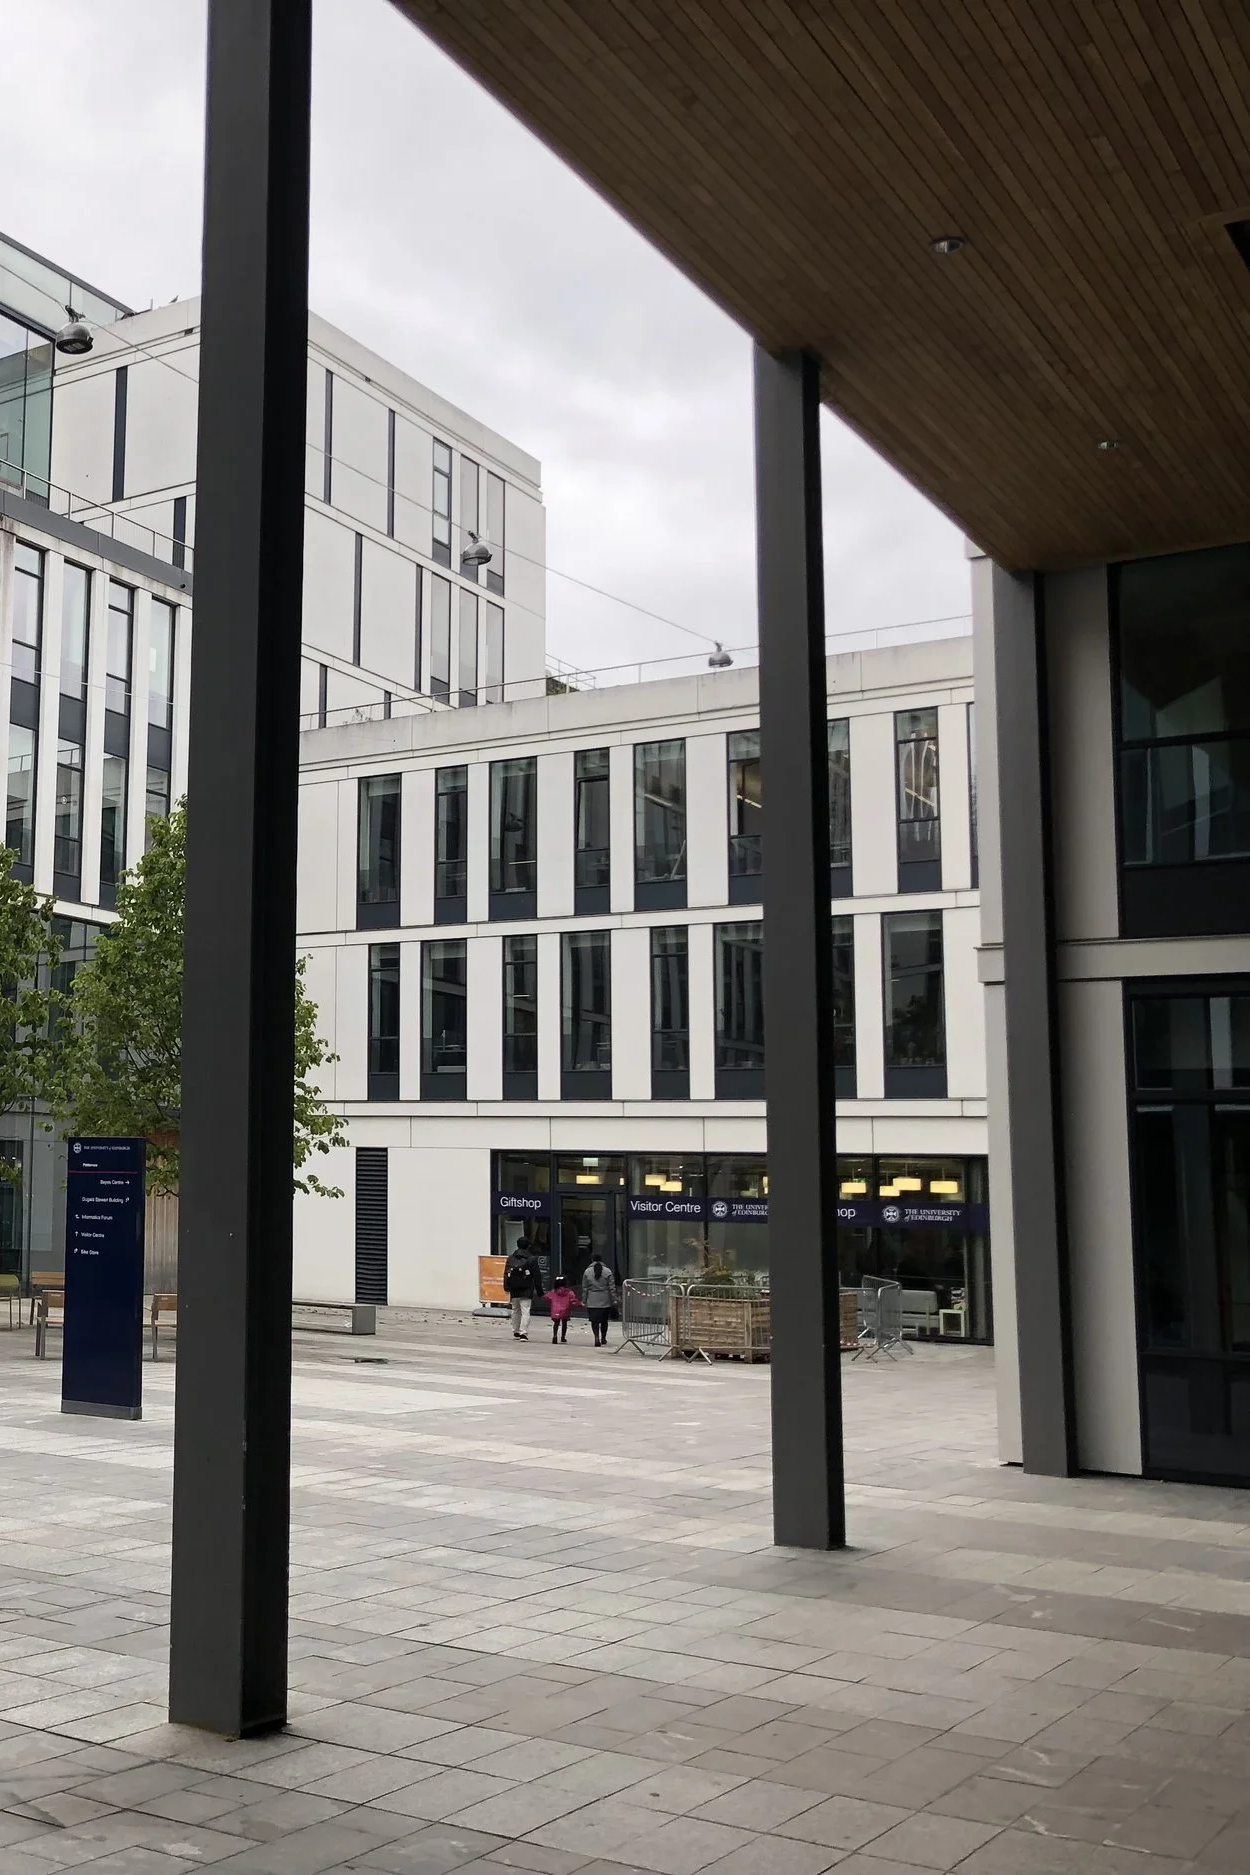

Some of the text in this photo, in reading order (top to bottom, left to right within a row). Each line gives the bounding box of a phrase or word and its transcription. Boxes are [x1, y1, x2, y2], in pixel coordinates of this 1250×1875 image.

[500, 1197, 542, 1210] Giftshop
[630, 1200, 701, 1213] Visitor Centre
[920, 1209, 961, 1217] UNIVERSITY
